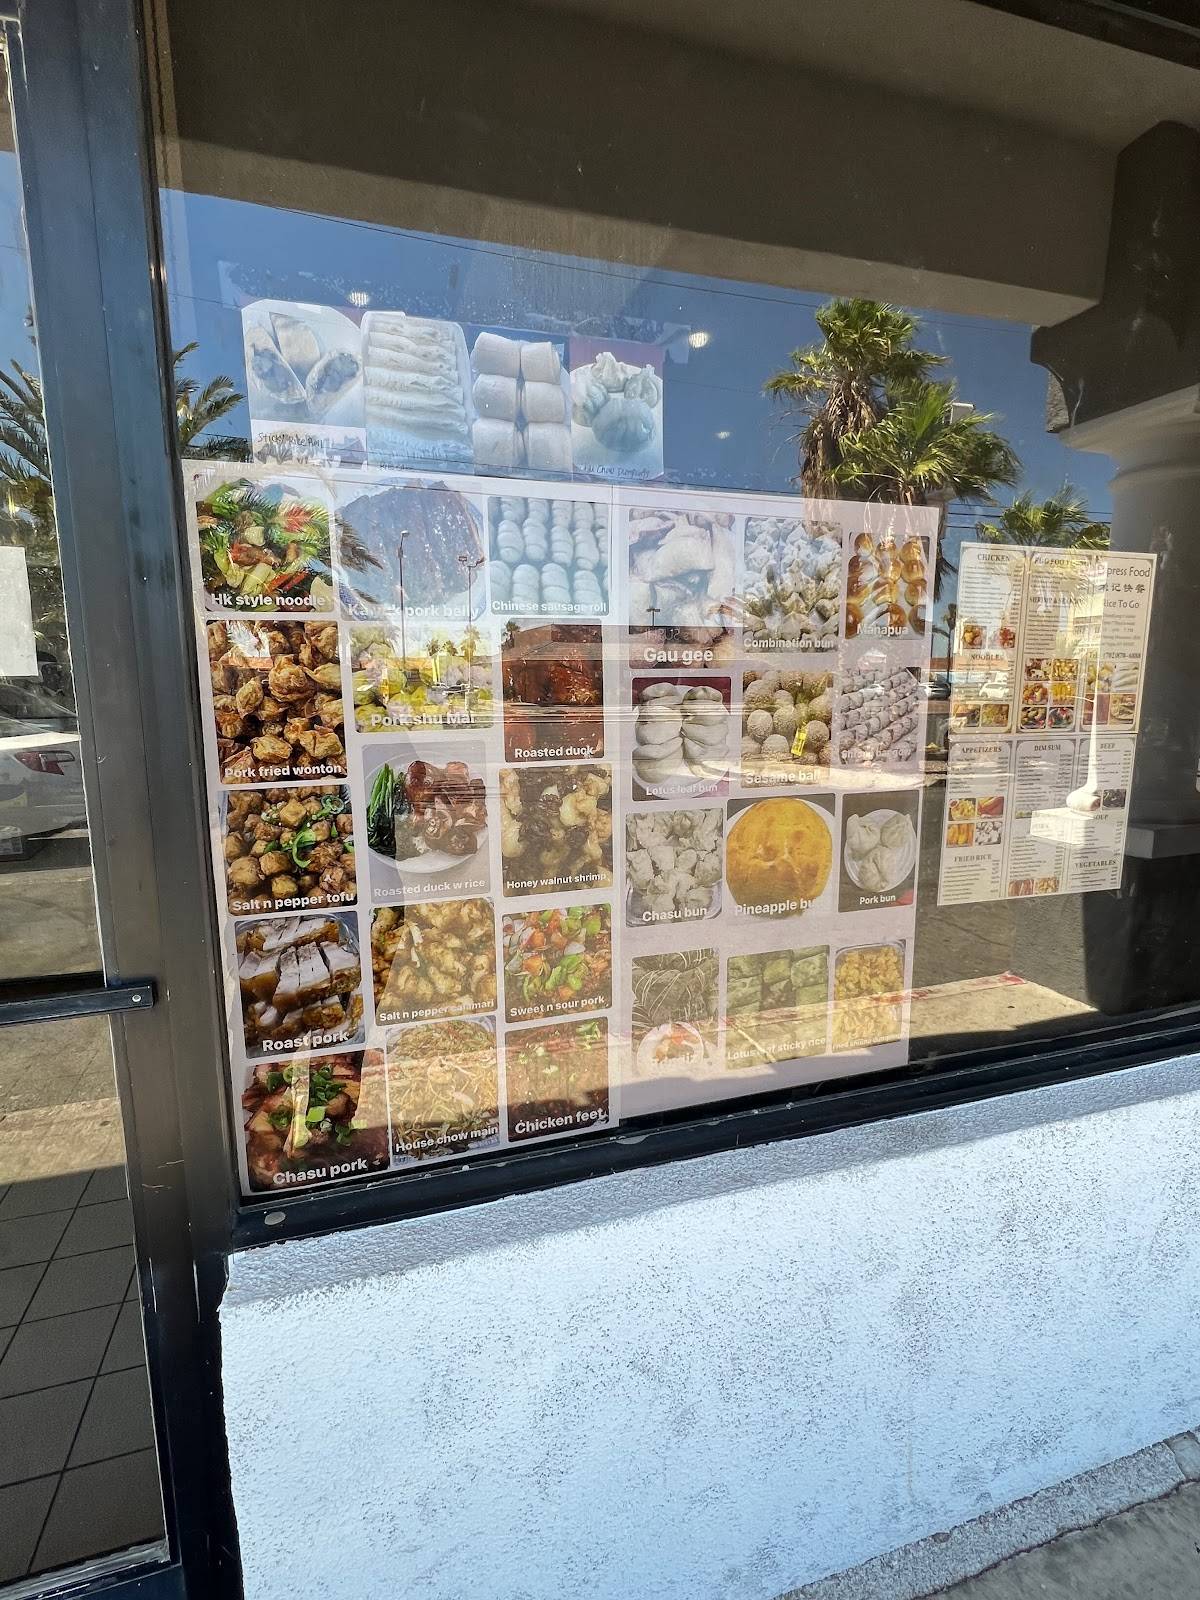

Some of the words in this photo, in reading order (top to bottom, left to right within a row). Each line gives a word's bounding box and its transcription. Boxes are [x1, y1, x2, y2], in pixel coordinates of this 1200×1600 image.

[977, 553, 1010, 562] CHICKEN
[1129, 566, 1151, 578] Food
[211, 593, 233, 605] Hk
[236, 593, 273, 608] style
[275, 593, 326, 606] noodle
[491, 600, 539, 611] Chinese
[1118, 599, 1127, 608] To
[1128, 600, 1139, 609] Go
[406, 604, 440, 617] pork
[443, 604, 479, 620] belly
[856, 623, 909, 637] Manapua
[743, 637, 812, 648] Combination
[814, 637, 834, 648] bun
[643, 647, 678, 663] Gau
[681, 649, 714, 665] gee
[514, 746, 563, 758] Roasted
[565, 745, 595, 756] duck
[962, 746, 1003, 754] APPETIZERS
[224, 767, 255, 778] Pork
[258, 765, 290, 777] fried
[293, 764, 342, 776] wonton
[506, 879, 539, 889] Honey
[540, 875, 573, 886] walnut
[574, 871, 607, 882] shrimp
[373, 884, 421, 897] Roasted
[423, 881, 451, 892] duck
[464, 879, 486, 889] rice
[232, 899, 260, 911] Salt
[263, 900, 272, 909] n
[274, 894, 323, 910] pepper
[326, 892, 354, 903] tofu
[859, 895, 879, 905] Pork
[880, 894, 896, 903] bun
[642, 909, 682, 922] Chasu
[684, 906, 708, 918] bun
[735, 899, 798, 916] Pineapple
[379, 1011, 401, 1021] Salt
[402, 1010, 410, 1019] n
[411, 1006, 449, 1019] pepper
[510, 1004, 545, 1017] Sweet
[546, 1003, 554, 1012] n
[555, 1000, 580, 1010] sour
[580, 995, 605, 1008] pork
[262, 1034, 310, 1052] Roast
[312, 1030, 350, 1048] pork
[515, 1114, 573, 1134] Chicken
[575, 1107, 606, 1123] feet
[395, 1138, 434, 1153] House
[436, 1131, 469, 1144] chow
[470, 1125, 499, 1139] main
[272, 1167, 327, 1184] Chasu
[329, 1157, 368, 1177] pork
